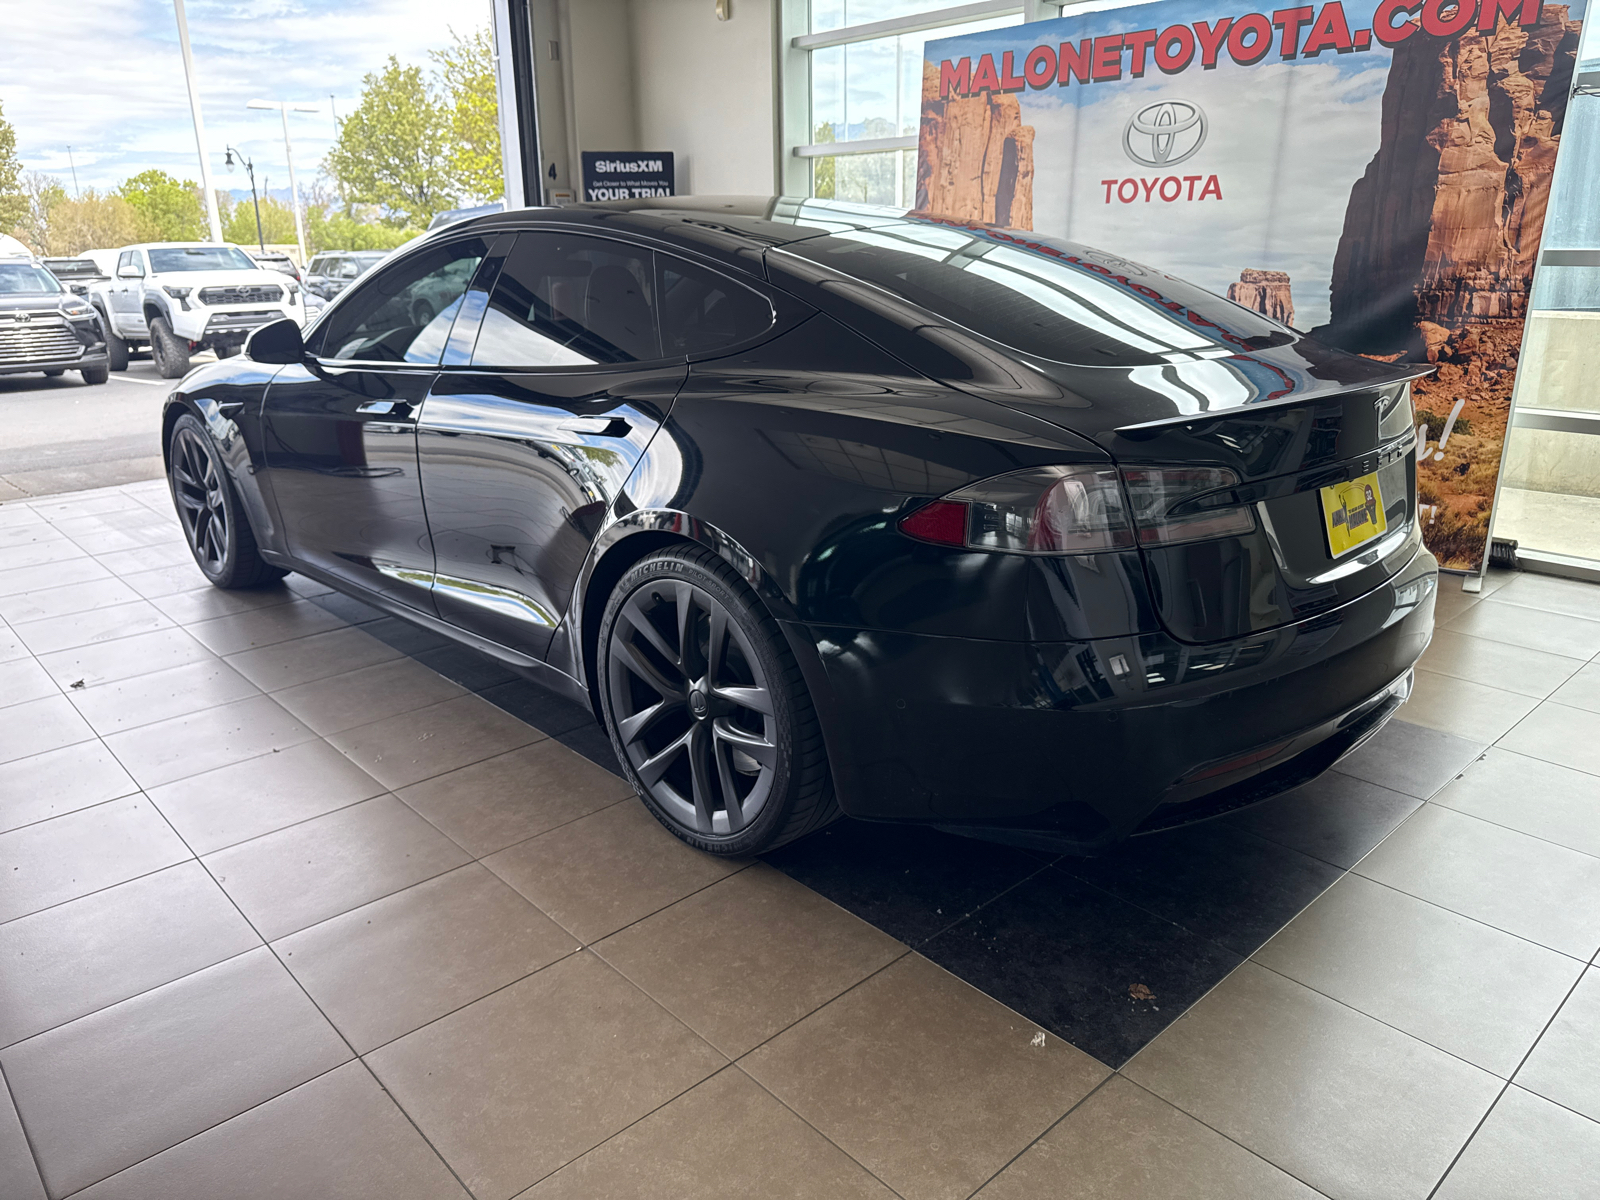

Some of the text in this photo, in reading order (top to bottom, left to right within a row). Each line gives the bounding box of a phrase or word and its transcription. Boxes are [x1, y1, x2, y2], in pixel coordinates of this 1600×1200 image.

[939, 0, 1543, 99] MALONETOYOTA.COM
[548, 163, 557, 180] 4
[595, 160, 663, 173] SiriusXM
[588, 188, 630, 201] YOUR
[1101, 174, 1223, 204] TOYOTA
[630, 561, 730, 599] MICHELIN PILOT SPORT
